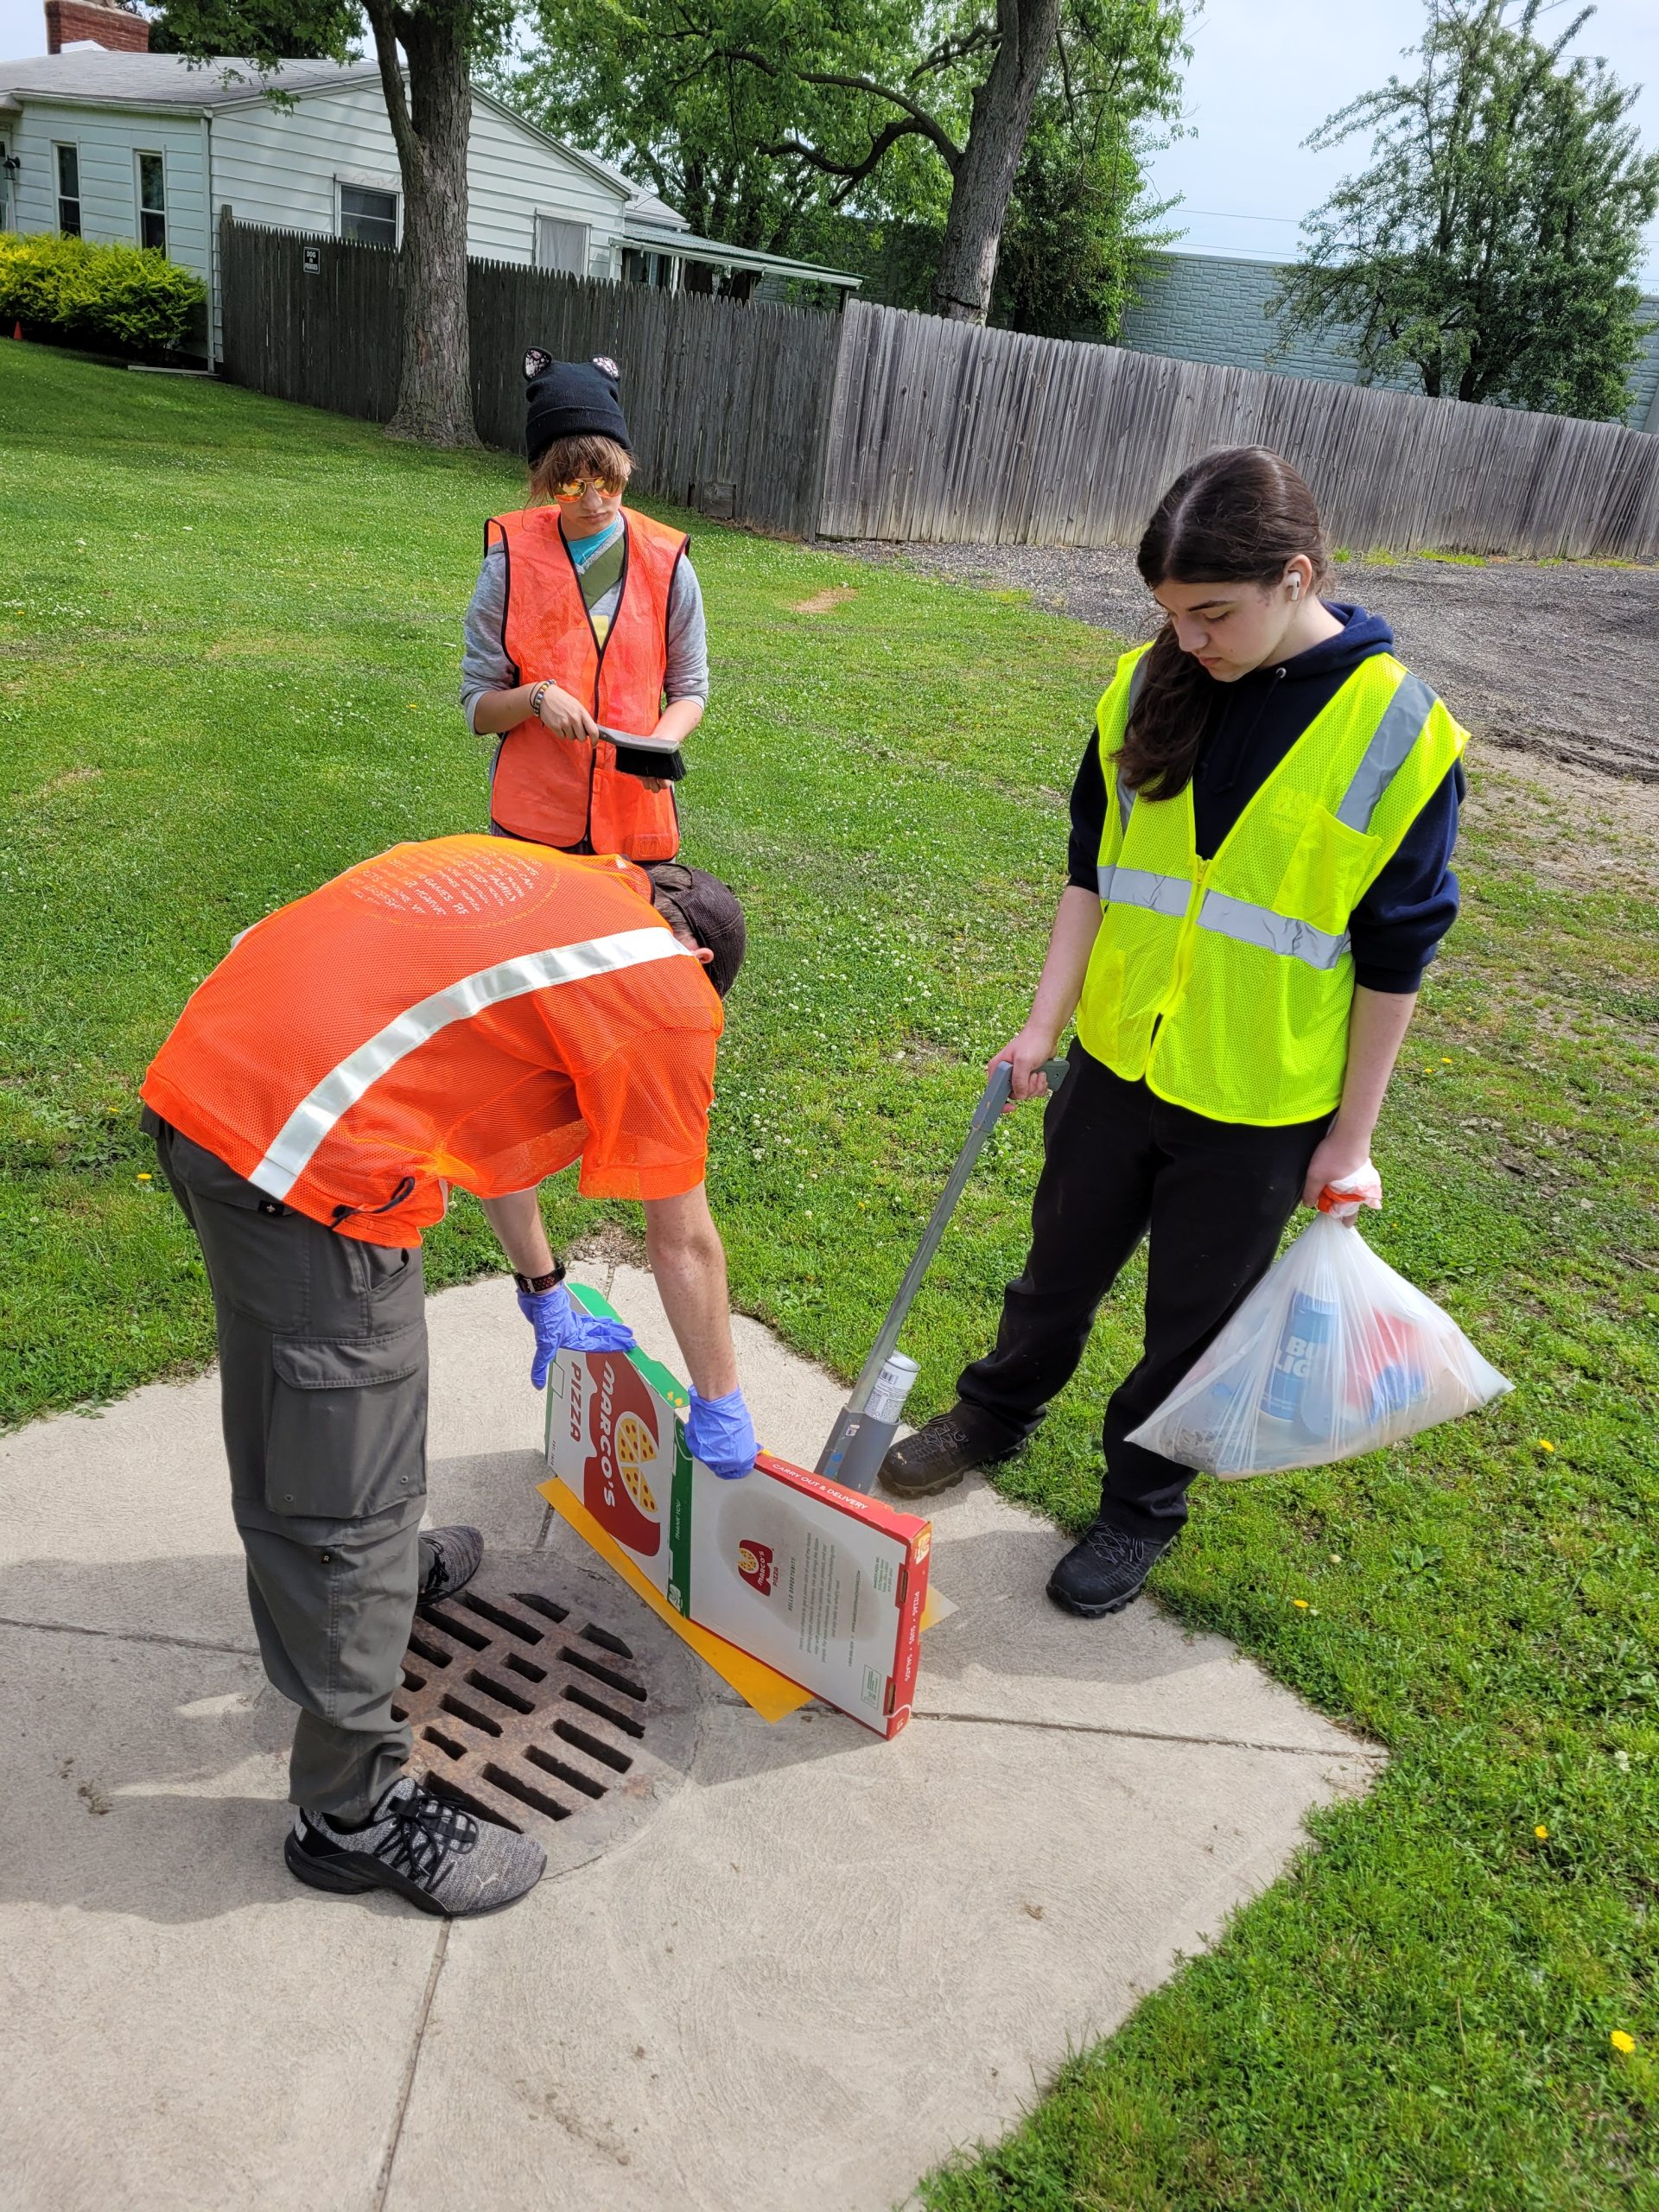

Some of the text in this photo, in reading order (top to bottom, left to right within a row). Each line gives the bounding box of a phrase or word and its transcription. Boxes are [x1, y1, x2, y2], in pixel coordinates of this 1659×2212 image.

[570, 1361, 581, 1443] PIZZA
[600, 1360, 615, 1507] MARCO'S
[772, 1464, 802, 1478] CARRY
[801, 1477, 820, 1487] OUT
[827, 1488, 868, 1510] DELIVERY
